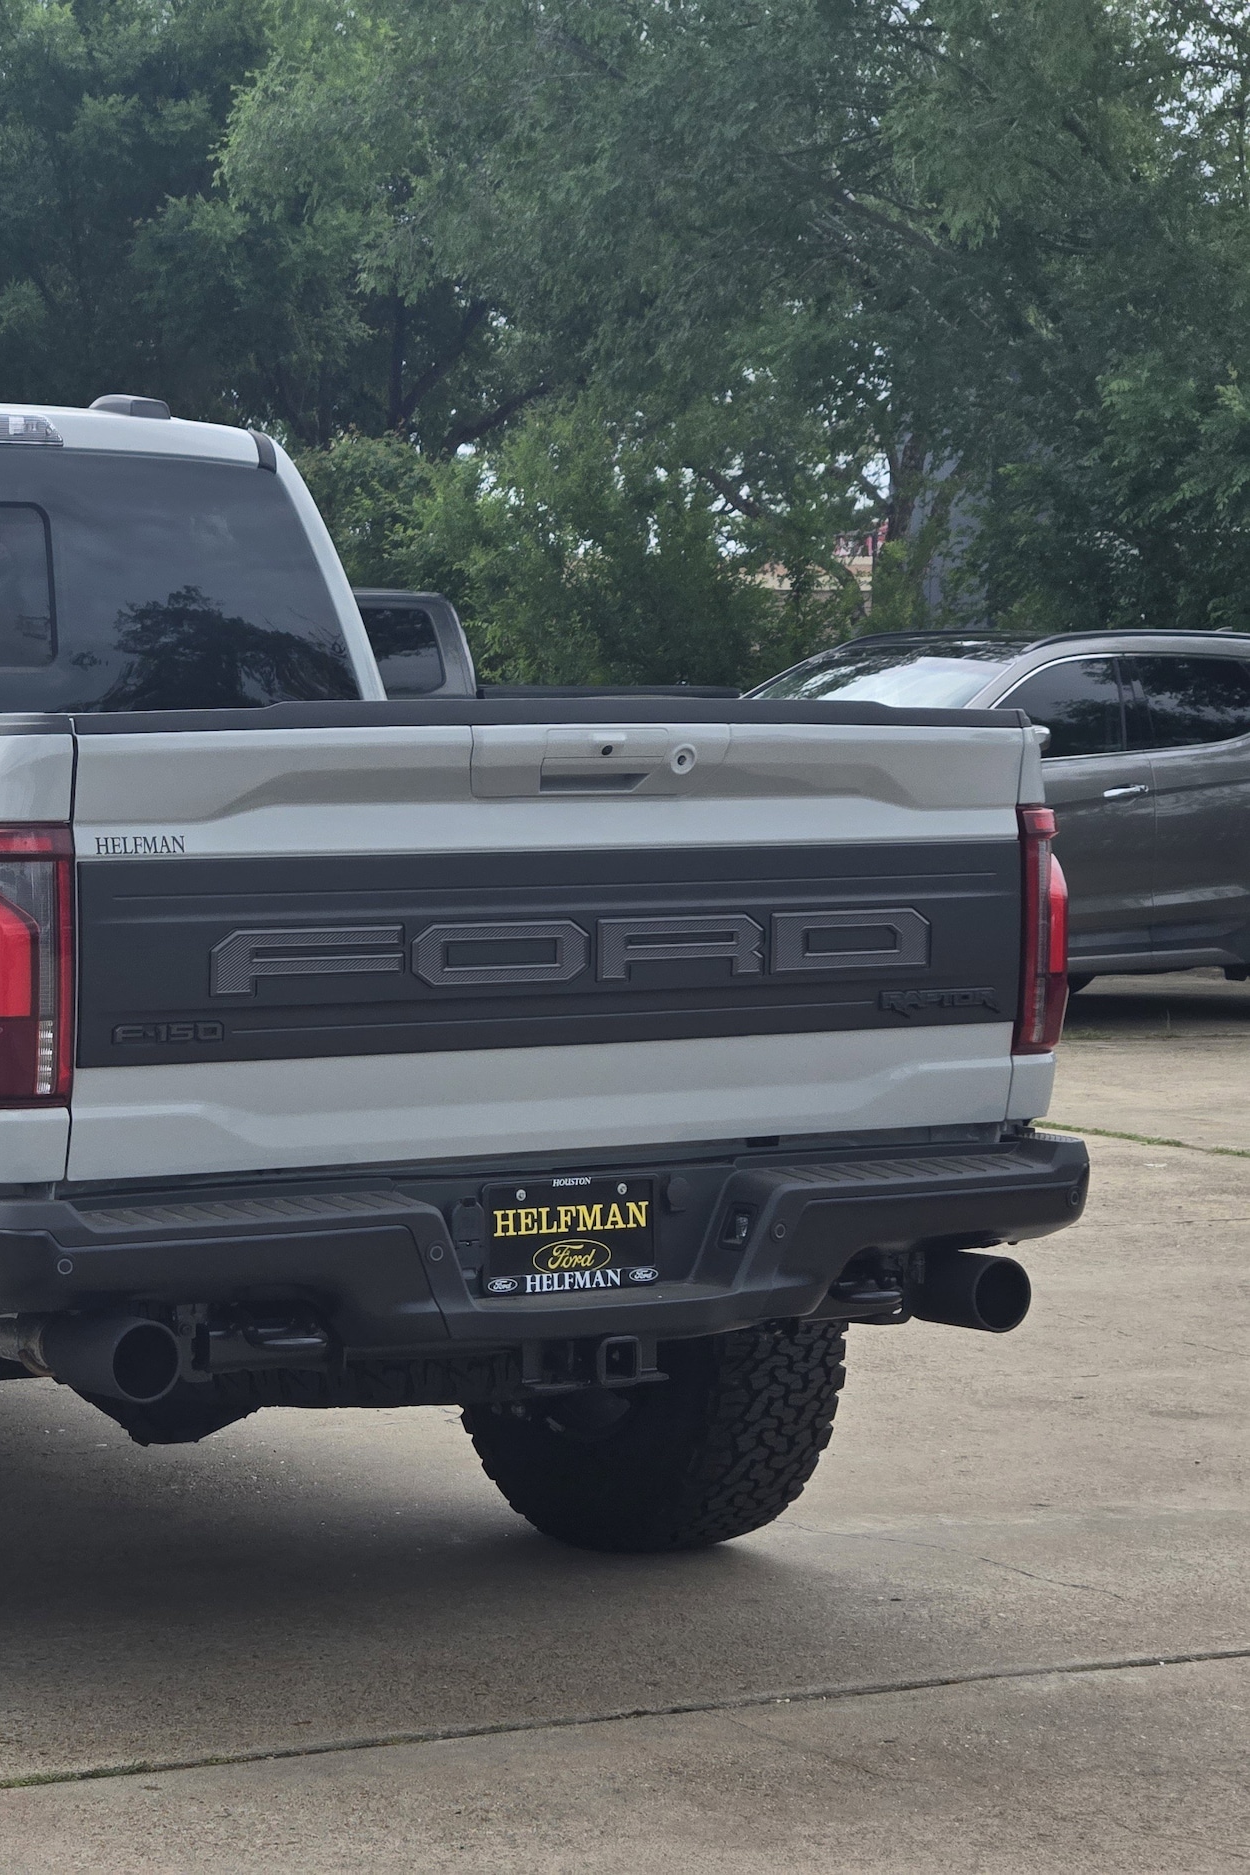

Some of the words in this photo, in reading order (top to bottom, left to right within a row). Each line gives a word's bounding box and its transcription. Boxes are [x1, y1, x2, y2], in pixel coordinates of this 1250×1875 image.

[95, 835, 186, 855] HELFMAN
[209, 907, 932, 999] FORD
[879, 986, 1001, 1020] RAPTOR
[111, 1020, 225, 1045] F-150
[552, 1176, 592, 1188] HOUSTON
[493, 1200, 649, 1237] HELFMAN
[547, 1244, 596, 1269] Ford
[524, 1268, 623, 1293] HELFMAN
